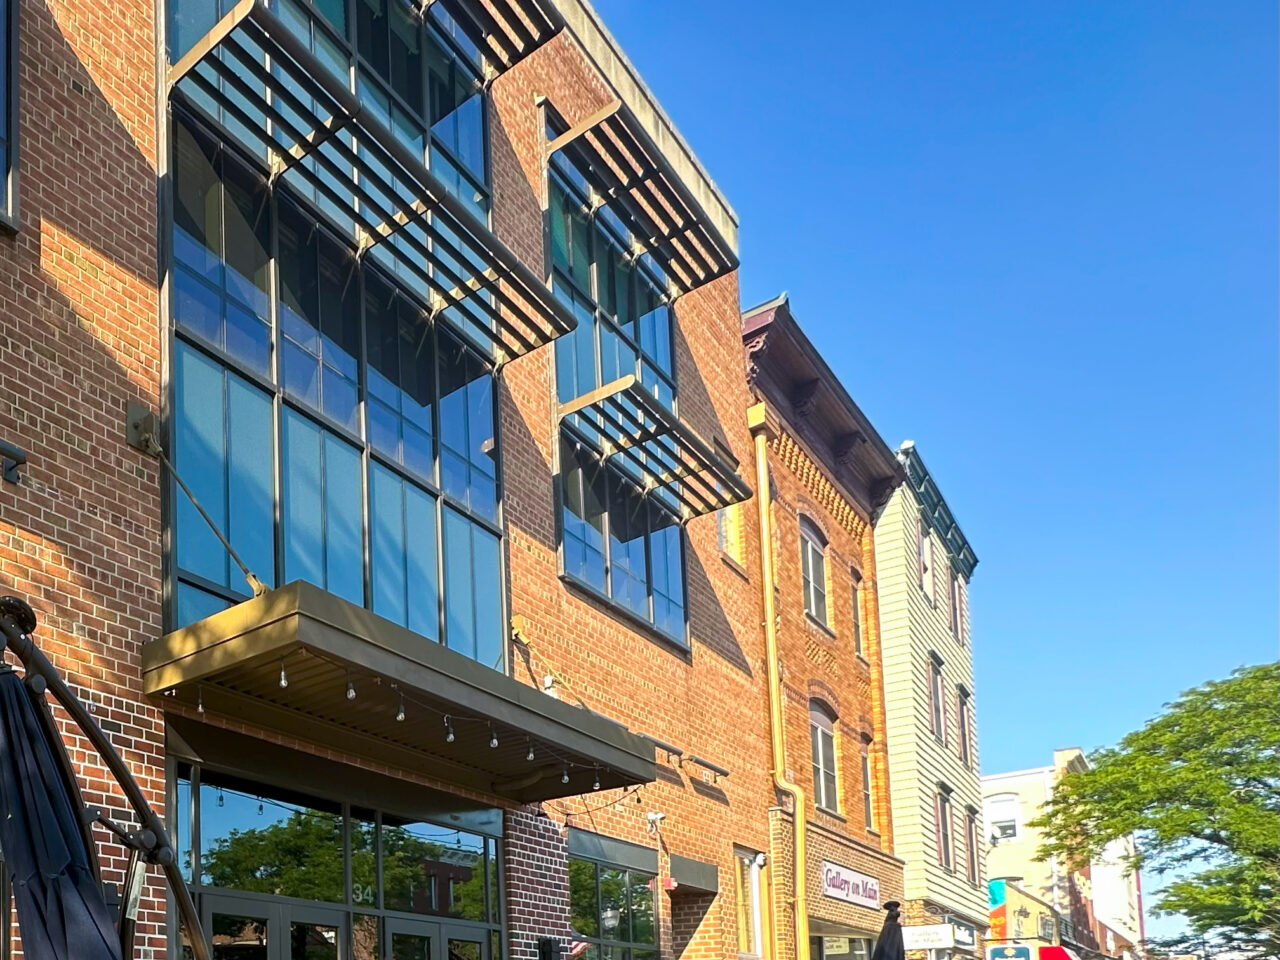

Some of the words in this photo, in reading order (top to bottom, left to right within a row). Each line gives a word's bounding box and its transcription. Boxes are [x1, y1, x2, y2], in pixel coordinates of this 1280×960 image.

[352, 883, 375, 904] 34
[825, 868, 851, 898] Gallery
[851, 882, 860, 896] on
[861, 880, 877, 900] Main
